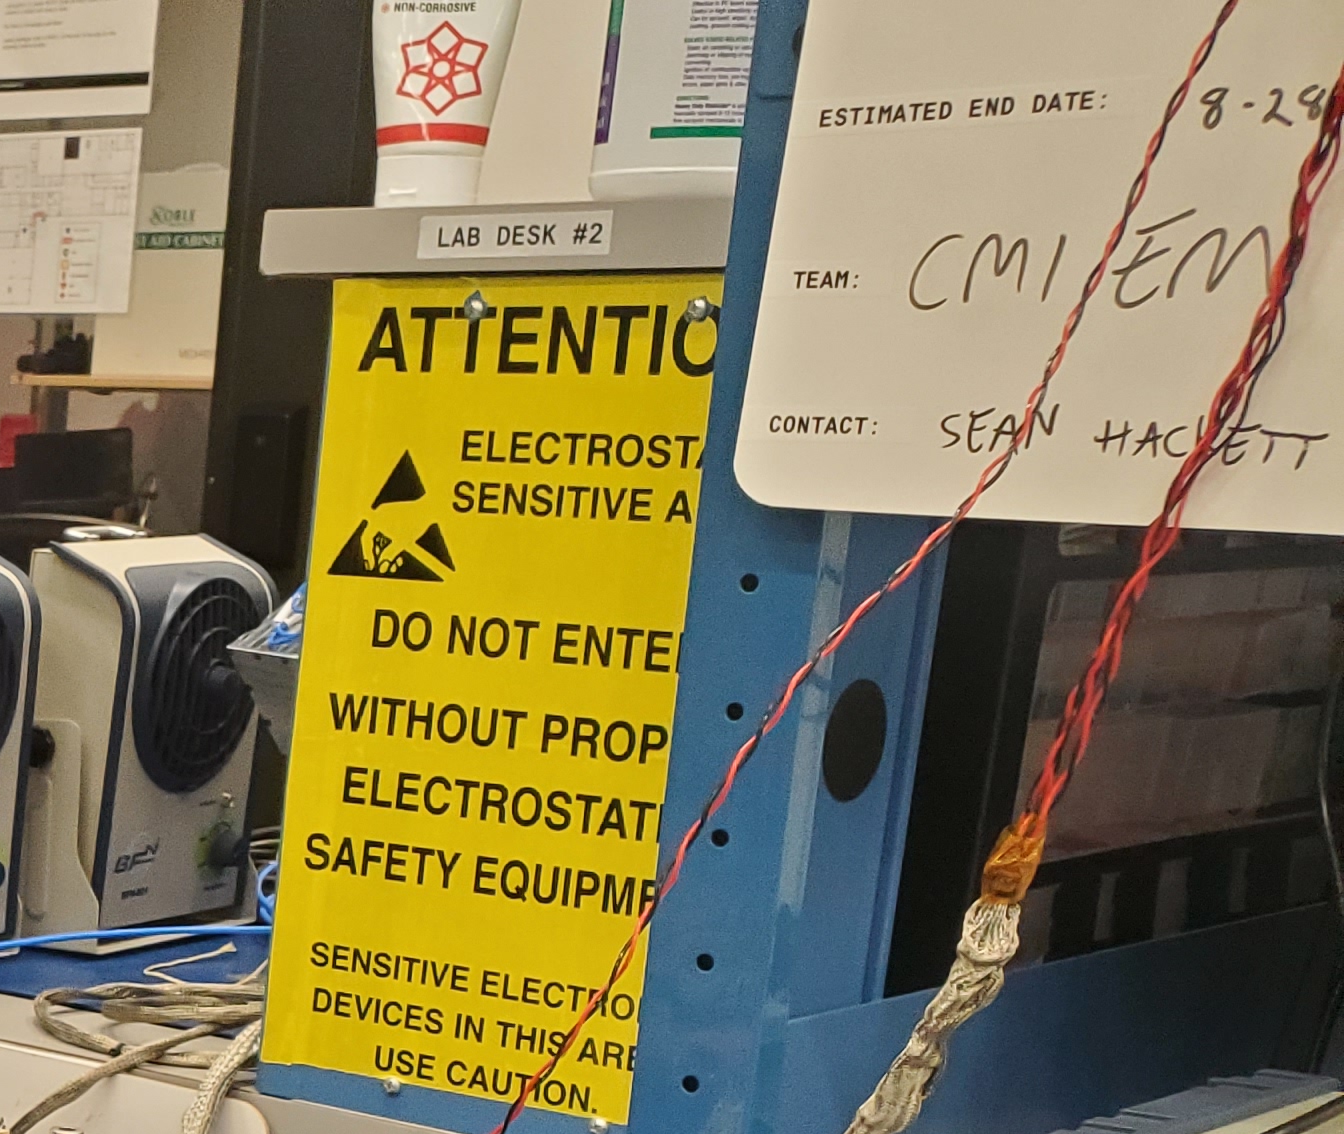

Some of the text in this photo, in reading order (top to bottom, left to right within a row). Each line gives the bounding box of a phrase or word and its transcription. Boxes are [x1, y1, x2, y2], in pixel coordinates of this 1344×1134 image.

[393, 2, 476, 12] NON-CORROSIVE
[819, 90, 1109, 129] ESTIMATED END DATE:
[437, 222, 603, 248] LAB DESK #2
[793, 271, 860, 290] TEAM:
[357, 304, 721, 377] ATTENTIO
[460, 430, 703, 469] ELECTROST
[768, 415, 878, 437] CONTACT:
[940, 403, 1060, 455] SEAN
[452, 480, 692, 524] SENSITIVE A
[371, 608, 682, 674] DO NOT ENTE
[328, 692, 669, 765] WITHOUT PROP
[304, 833, 463, 890] SAFETY
[310, 942, 642, 1024] SENSITIVE ELECTRO
[312, 987, 444, 1034] DEVICES
[454, 1012, 485, 1043] IN
[496, 1021, 567, 1057] THIS
[374, 1045, 598, 1114] USE CAUTION.
